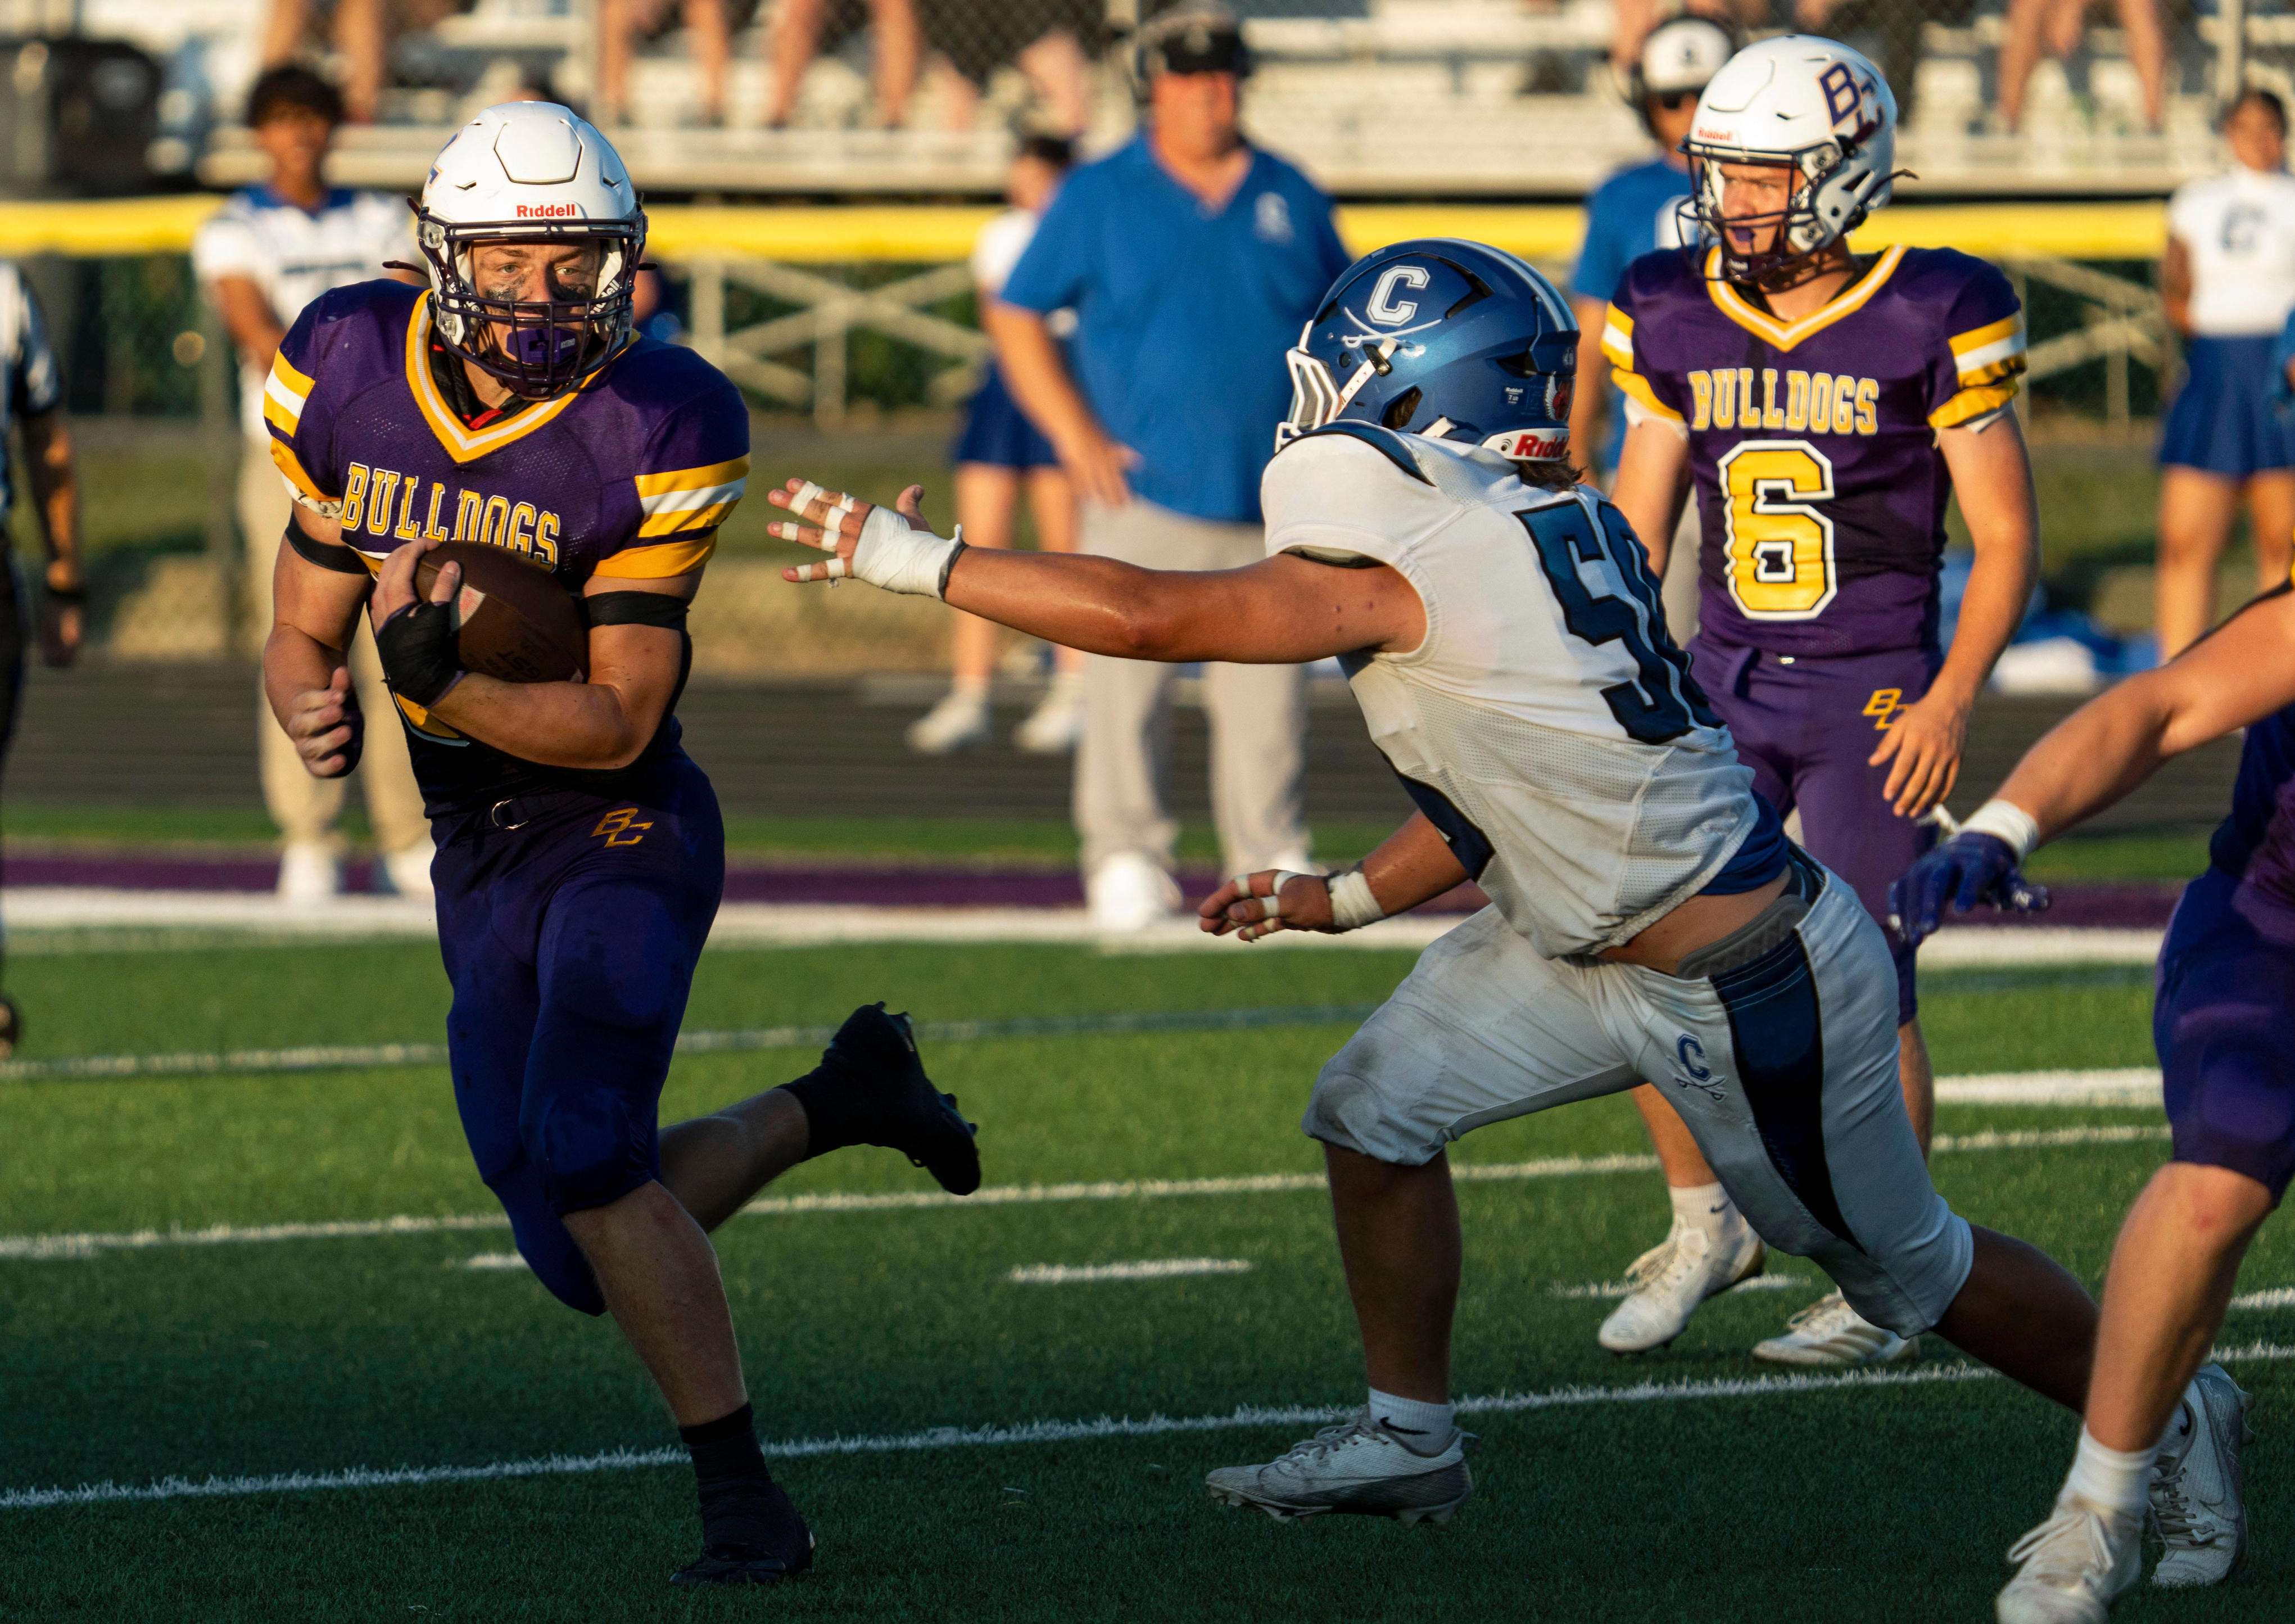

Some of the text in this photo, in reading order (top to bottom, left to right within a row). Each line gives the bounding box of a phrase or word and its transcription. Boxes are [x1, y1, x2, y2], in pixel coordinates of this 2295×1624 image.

[516, 203, 576, 218] Riddell
[1366, 265, 1431, 327] C
[1687, 368, 1880, 436] BULLDOGS
[341, 462, 561, 574] BULLDOGS
[1717, 440, 1838, 621] 6
[589, 807, 654, 848] BC
[1677, 1033, 1712, 1083] C
